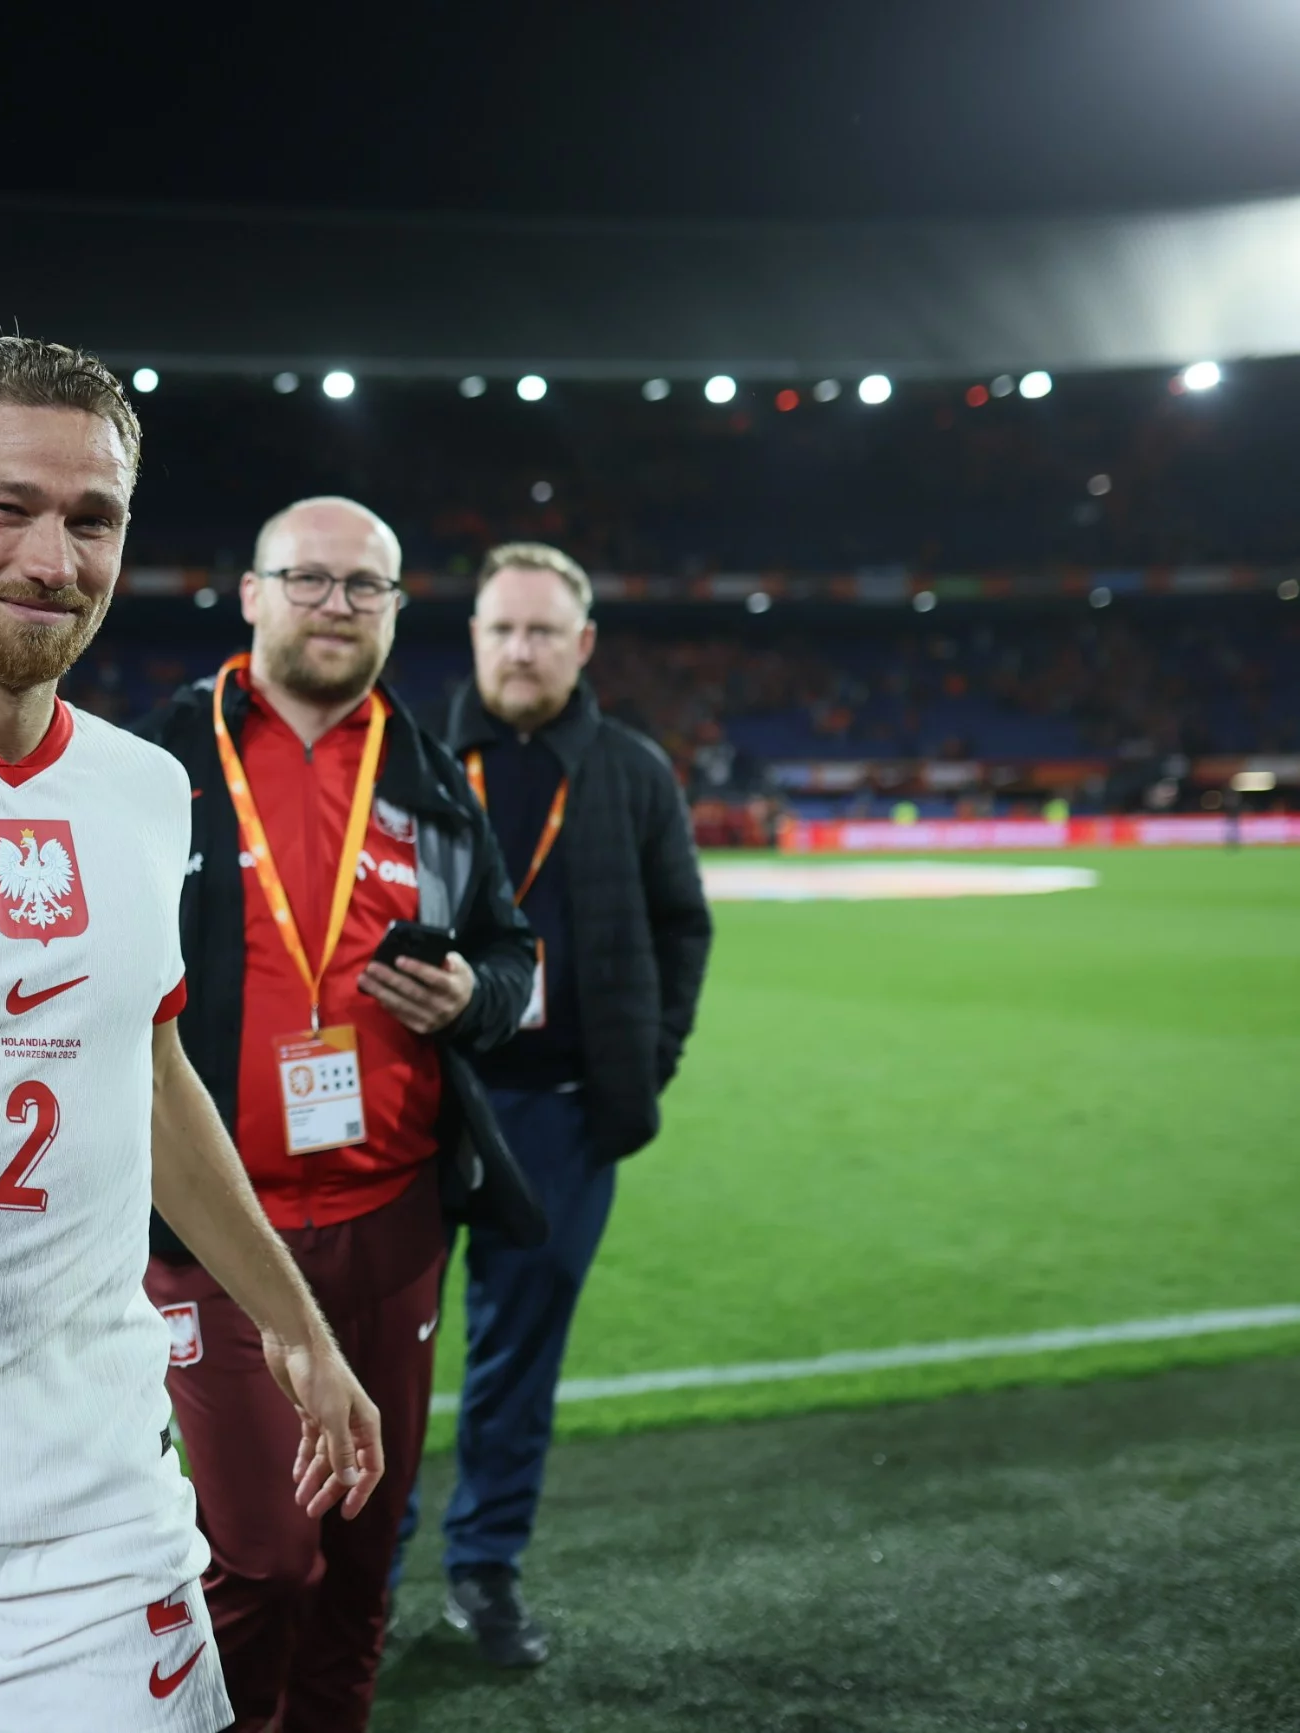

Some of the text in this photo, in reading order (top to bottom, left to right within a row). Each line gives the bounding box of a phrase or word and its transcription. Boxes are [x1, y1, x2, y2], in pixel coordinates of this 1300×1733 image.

[0, 1037, 81, 1048] HOLANDIA-POLSKA
[4, 1049, 78, 1059] 04 WRZEŚNIA 2025
